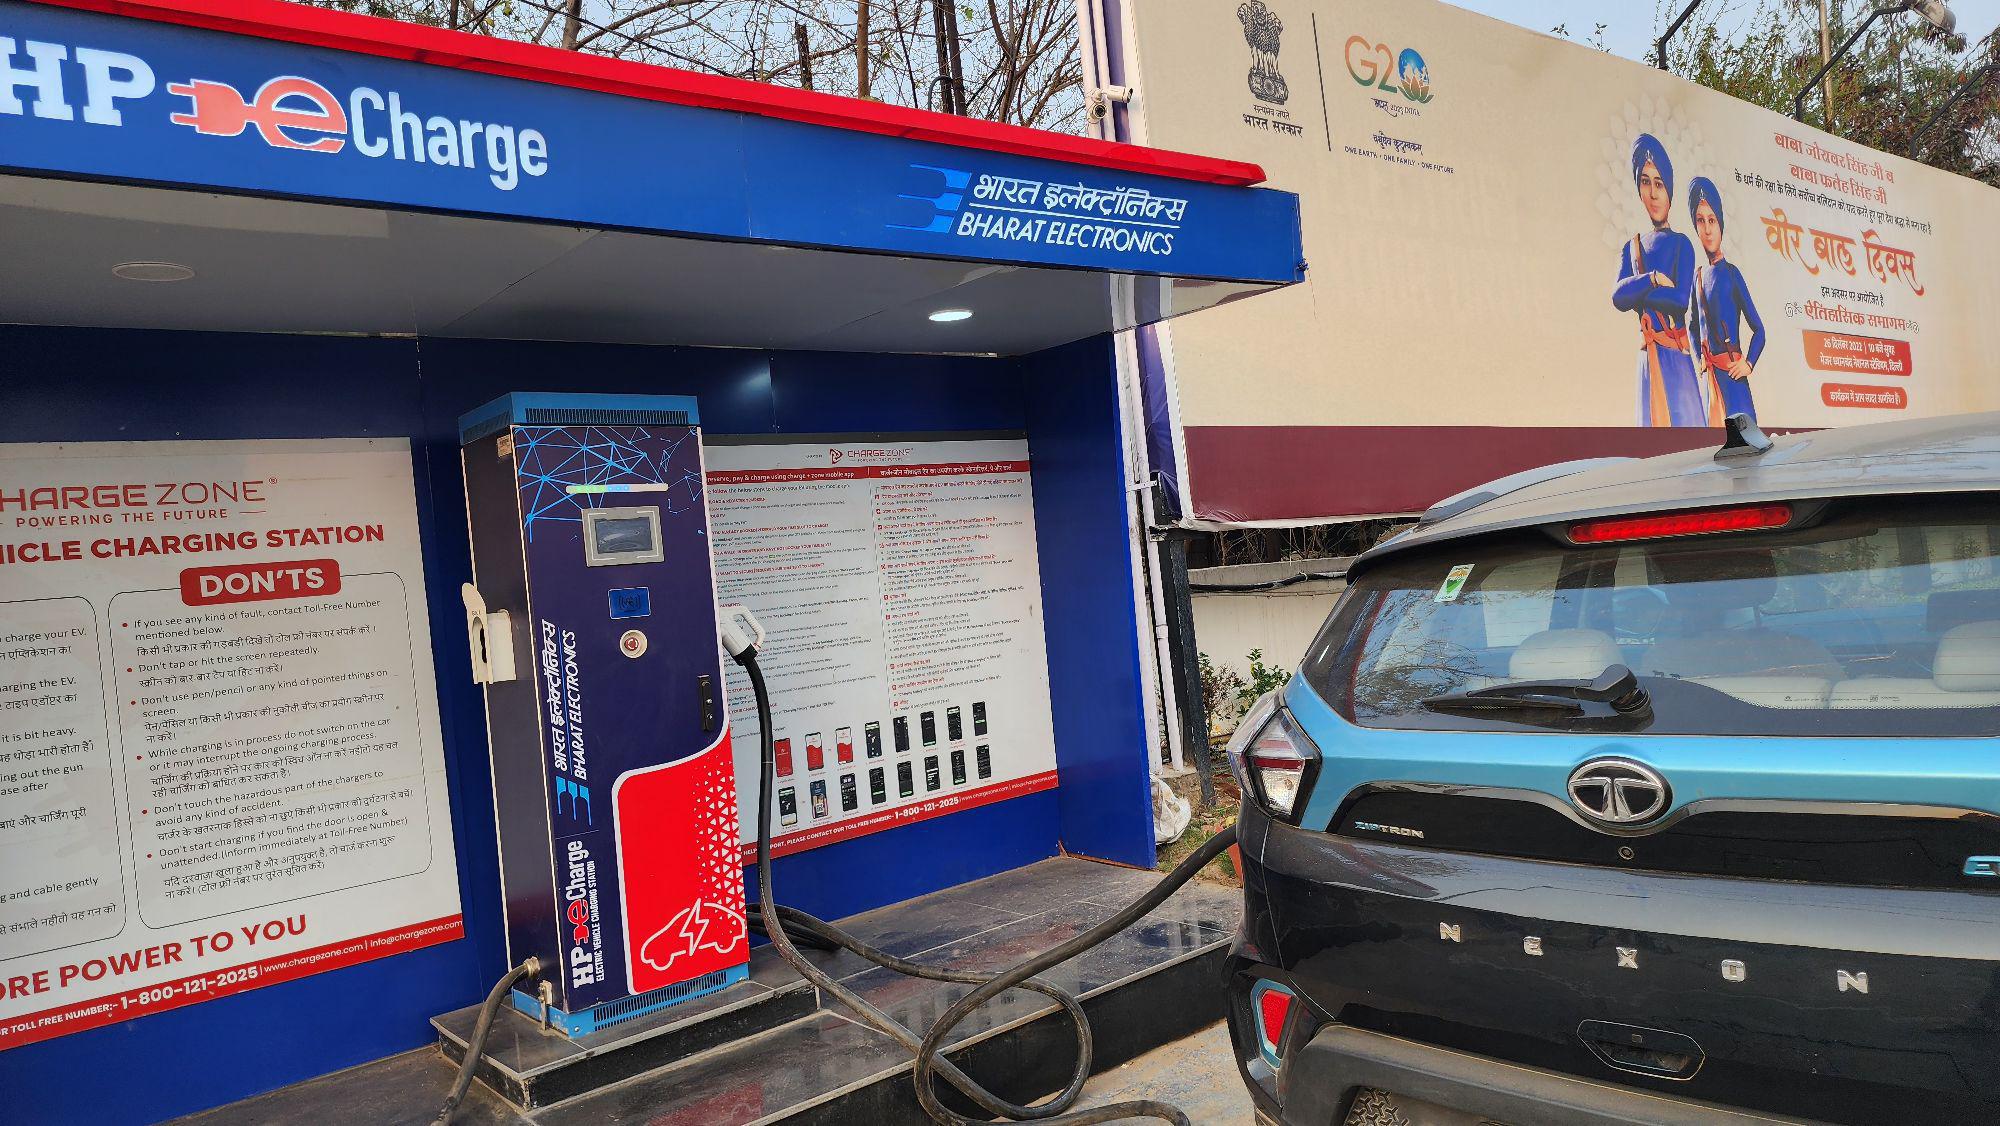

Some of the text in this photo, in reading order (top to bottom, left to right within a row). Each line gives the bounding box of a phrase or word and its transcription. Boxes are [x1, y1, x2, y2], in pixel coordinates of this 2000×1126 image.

[0, 36, 156, 127] HP
[1344, 35, 1433, 103] G20
[1243, 113, 1303, 138] भारत सरकार
[1344, 146, 1454, 174] ONE EARTH ONE FAMILY ONE FUTURE
[1774, 132, 1803, 155] बाबा
[1846, 152, 1868, 176] सिंह
[1868, 161, 1883, 181] जी
[1886, 171, 1895, 184] व
[1735, 168, 1742, 184] के
[1755, 174, 1764, 189] की
[1789, 164, 1818, 185] बाबा
[1850, 178, 1871, 201] सिंह
[1872, 187, 1887, 204] जी
[973, 172, 1188, 222] भारत इलेक्ट्रॉनिक्स
[957, 212, 1174, 256] BHARAT ELECTRONICS
[1760, 205, 1925, 296] वीर बाल दिवस
[1804, 300, 1906, 331] ऐतिहासिक समागम
[1849, 342, 1863, 352] 2022
[770, 473, 787, 481] using
[16, 508, 228, 528] POWERING THE FUTURE
[0, 524, 384, 565] ICLE CHARGING STATION
[200, 567, 324, 598] DON'TS
[133, 598, 381, 630] If you see any kind of fault, contact Toll-Free Number
[4, 628, 86, 643] charge your EV.
[134, 624, 224, 641] mentioned below.
[137, 644, 319, 673] Don't tap or hit the screen repeatedly.
[140, 669, 388, 706] Don't use pen/pencil or any kind of pointed things on
[541, 618, 568, 771] भारत इलेक्ट्रॉनिक्स
[562, 629, 587, 780] BHARAT ELECTRONICS
[141, 707, 179, 718] screen.
[1, 726, 77, 743] it is bit heavy.
[806, 828, 833, 840] CONTACT
[895, 797, 959, 820] 1-800-121-2025
[1354, 821, 1424, 839] ZIPTRON
[1963, 855, 2000, 877] E
[586, 860, 605, 982] ELECTRIC VEHICLE CHARGING STATION
[0, 914, 308, 1000] RE POWER TO YOU
[570, 946, 594, 989] HP
[10, 1021, 36, 1033] TOLL
[38, 1015, 63, 1027] FREE
[120, 966, 258, 1010] 1-800-121-2025
[264, 943, 363, 973] www.chargezone.com
[370, 921, 463, 948] info@chargezone.com
